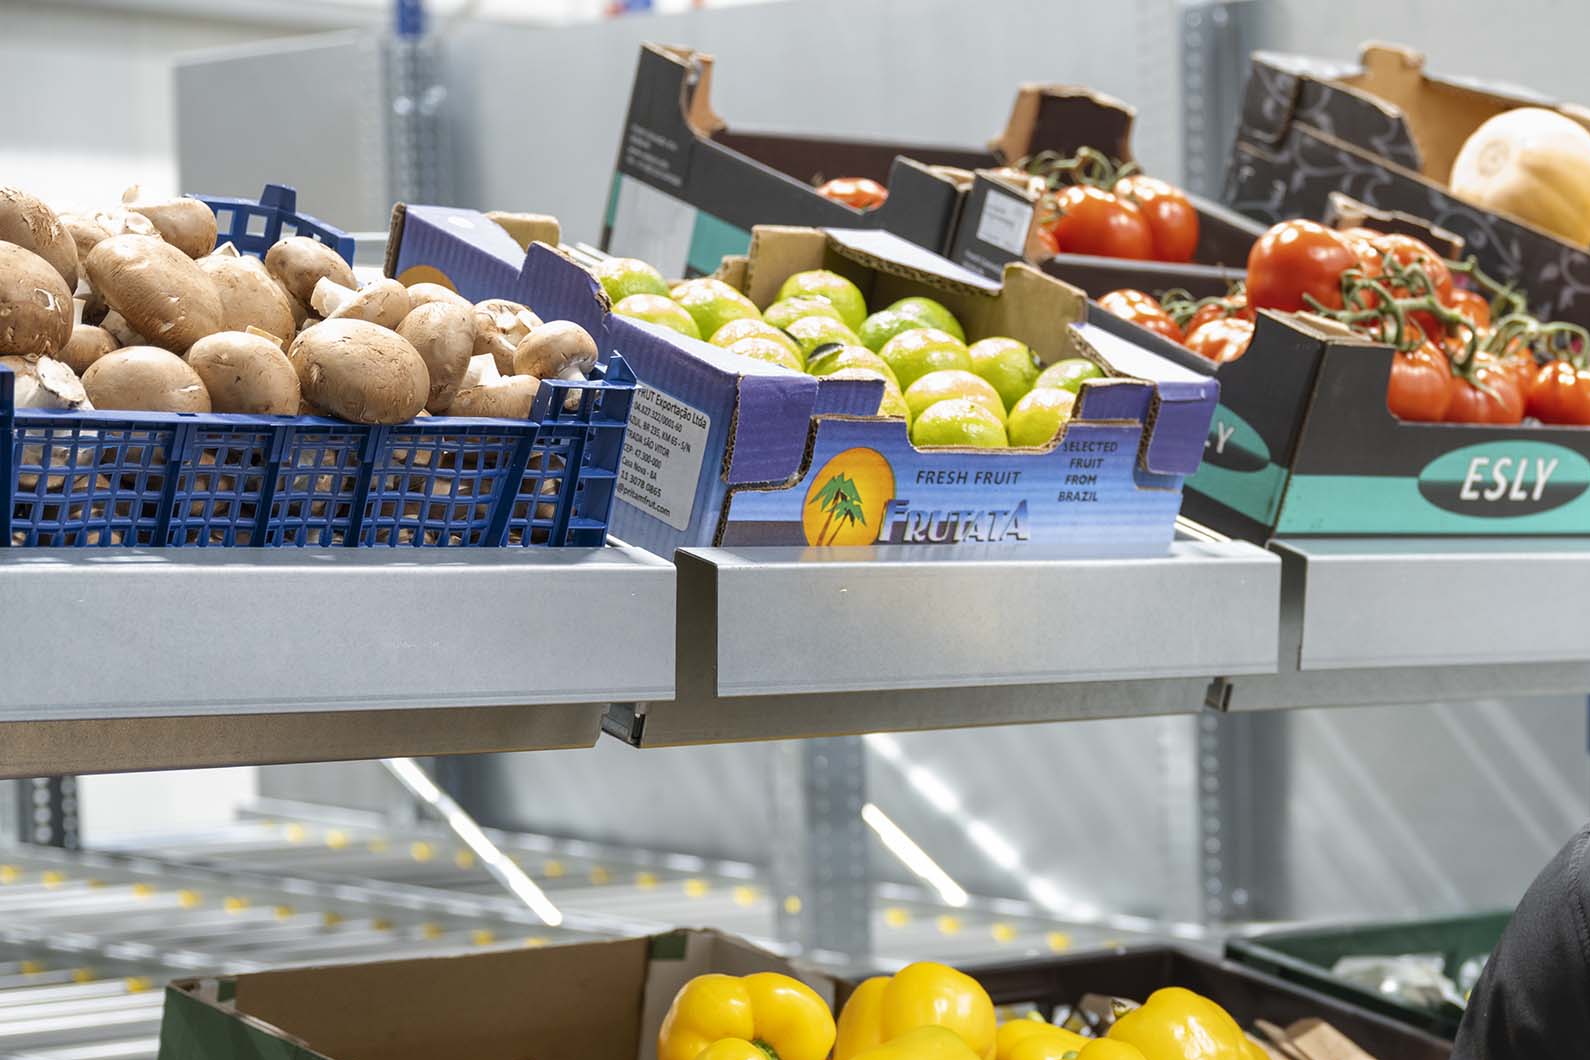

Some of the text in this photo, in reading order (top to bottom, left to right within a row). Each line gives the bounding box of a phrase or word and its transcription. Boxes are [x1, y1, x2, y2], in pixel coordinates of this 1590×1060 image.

[655, 393, 692, 421] Exportação
[692, 410, 708, 430] Ltda
[643, 435, 655, 451] SÃO
[654, 441, 670, 457] VITOR
[1070, 458, 1104, 469] FRUIT
[916, 470, 1022, 485] FRESH FRUIT
[1064, 474, 1098, 486] FROM
[1459, 456, 1559, 502] ESLY
[1057, 490, 1099, 502] BRAZIL
